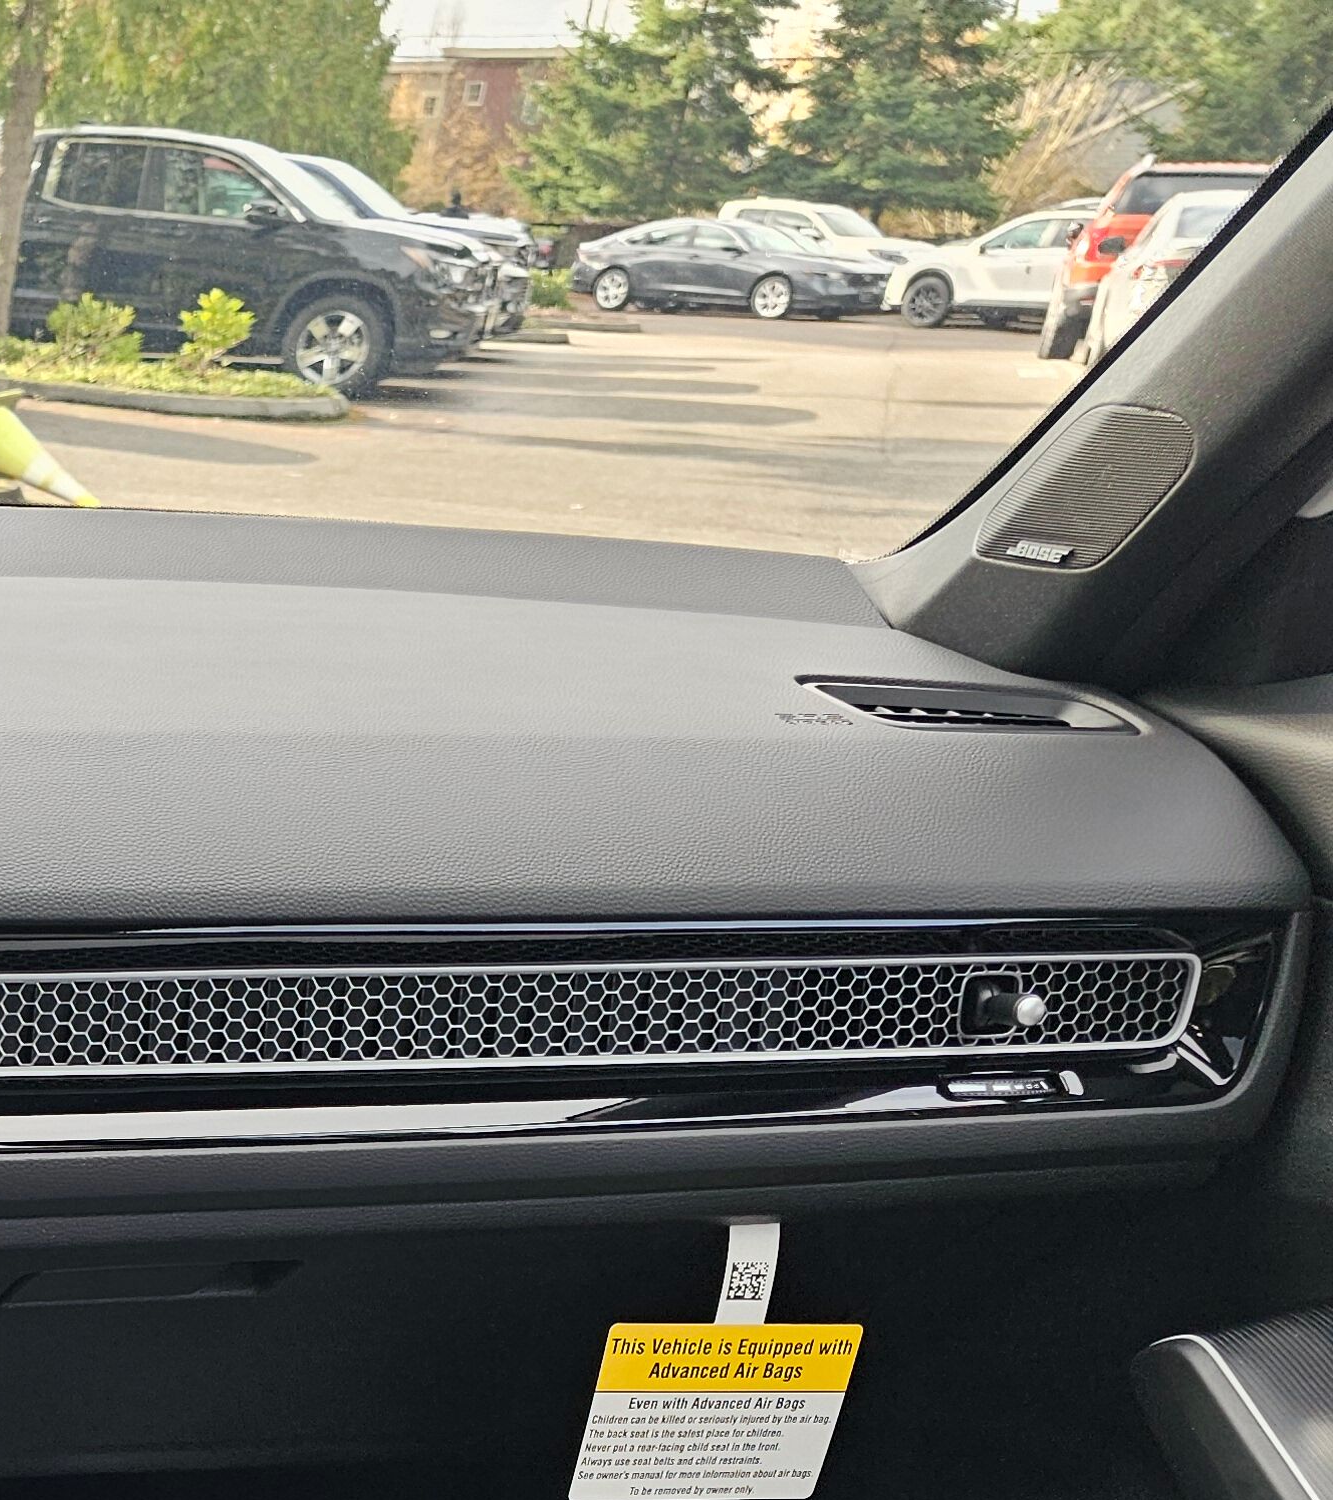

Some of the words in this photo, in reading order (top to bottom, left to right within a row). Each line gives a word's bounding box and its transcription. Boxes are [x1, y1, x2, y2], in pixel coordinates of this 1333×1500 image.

[612, 1338, 646, 1355] This
[652, 1338, 712, 1355] Vehicle
[718, 1338, 733, 1355] is
[737, 1338, 814, 1358] Equipped
[819, 1338, 853, 1355] with
[648, 1362, 730, 1378] Advanced
[734, 1362, 759, 1378] Air
[763, 1362, 803, 1382] Bags
[628, 1397, 658, 1409] Even
[662, 1397, 688, 1409] with
[691, 1397, 752, 1409] Advanced
[754, 1397, 773, 1409] Air
[776, 1397, 806, 1412] Bags
[592, 1414, 628, 1425] Children
[630, 1416, 646, 1424] can
[648, 1415, 659, 1424] be
[661, 1414, 685, 1424] killed
[687, 1416, 696, 1424] or
[698, 1414, 737, 1426] seriously
[739, 1414, 771, 1426] injured
[773, 1414, 784, 1425] by
[784, 1414, 797, 1424] the
[799, 1414, 813, 1424] air
[813, 1414, 831, 1425] bag.
[589, 1429, 604, 1438] The
[607, 1428, 627, 1439] back
[630, 1429, 649, 1438] seat
[650, 1429, 659, 1438] is
[661, 1429, 675, 1438] the
[677, 1429, 704, 1438] safest
[705, 1429, 729, 1439] place
[732, 1429, 745, 1438] for
[746, 1428, 784, 1438] children.
[585, 1443, 611, 1452] Never
[613, 1443, 627, 1453] put
[637, 1443, 685, 1453] rear-facing
[687, 1443, 709, 1452] child
[710, 1443, 730, 1451] seat
[731, 1443, 740, 1451] in
[742, 1443, 756, 1451] the
[757, 1442, 781, 1451] front.
[581, 1457, 612, 1468] Always
[615, 1458, 630, 1466] use
[632, 1457, 651, 1466] seat
[653, 1457, 674, 1466] belts
[677, 1457, 694, 1466] and
[695, 1457, 716, 1465] child
[719, 1457, 762, 1465] restraints.
[578, 1471, 594, 1480] See
[596, 1471, 629, 1480] owner's
[631, 1471, 664, 1480] manual
[665, 1471, 676, 1479] for
[702, 1470, 750, 1479] information
[753, 1470, 778, 1479] about
[778, 1470, 791, 1478] air
[629, 1487, 639, 1496] To
[641, 1487, 652, 1495] be
[654, 1486, 692, 1496] removed
[693, 1486, 704, 1497] by
[706, 1487, 734, 1495] owner
[734, 1485, 755, 1496] only.
